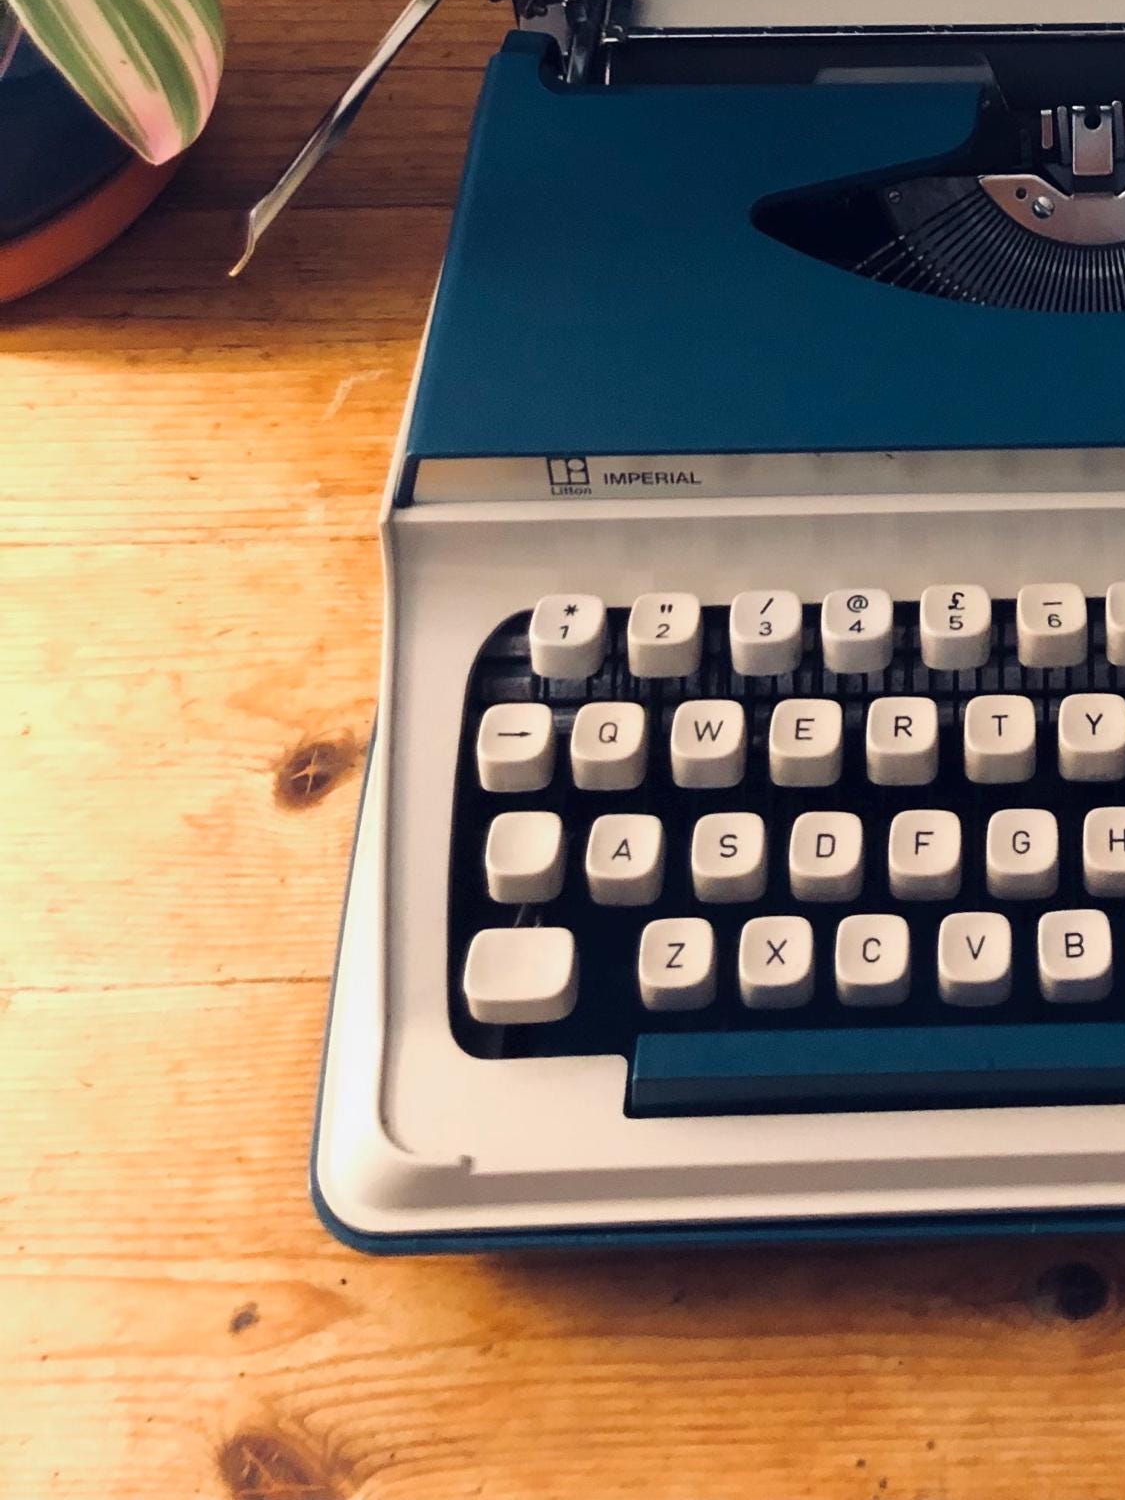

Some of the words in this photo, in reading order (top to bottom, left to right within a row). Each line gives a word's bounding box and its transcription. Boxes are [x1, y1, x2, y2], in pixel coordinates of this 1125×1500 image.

[603, 471, 702, 485] IMPERIAL
[550, 484, 593, 497] Litton
[759, 597, 774, 615] /
[846, 594, 869, 614] @
[947, 591, 965, 611] £
[655, 623, 670, 640] 2
[758, 621, 773, 637] 3
[848, 619, 865, 634] 4
[948, 614, 964, 631] 5
[1047, 613, 1063, 629] 6
[598, 721, 618, 744] Q
[693, 720, 724, 743] W
[794, 717, 815, 741] E
[893, 715, 913, 738] R
[991, 714, 1009, 737] T
[1085, 713, 1104, 736] Y
[611, 838, 632, 861] A
[719, 833, 738, 859] S
[815, 833, 836, 859] D
[914, 830, 935, 856] F
[1011, 830, 1031, 855] G
[665, 942, 686, 969] Z
[765, 939, 788, 966] X
[862, 937, 881, 964] C
[965, 935, 986, 961] V
[1064, 932, 1085, 959] B
